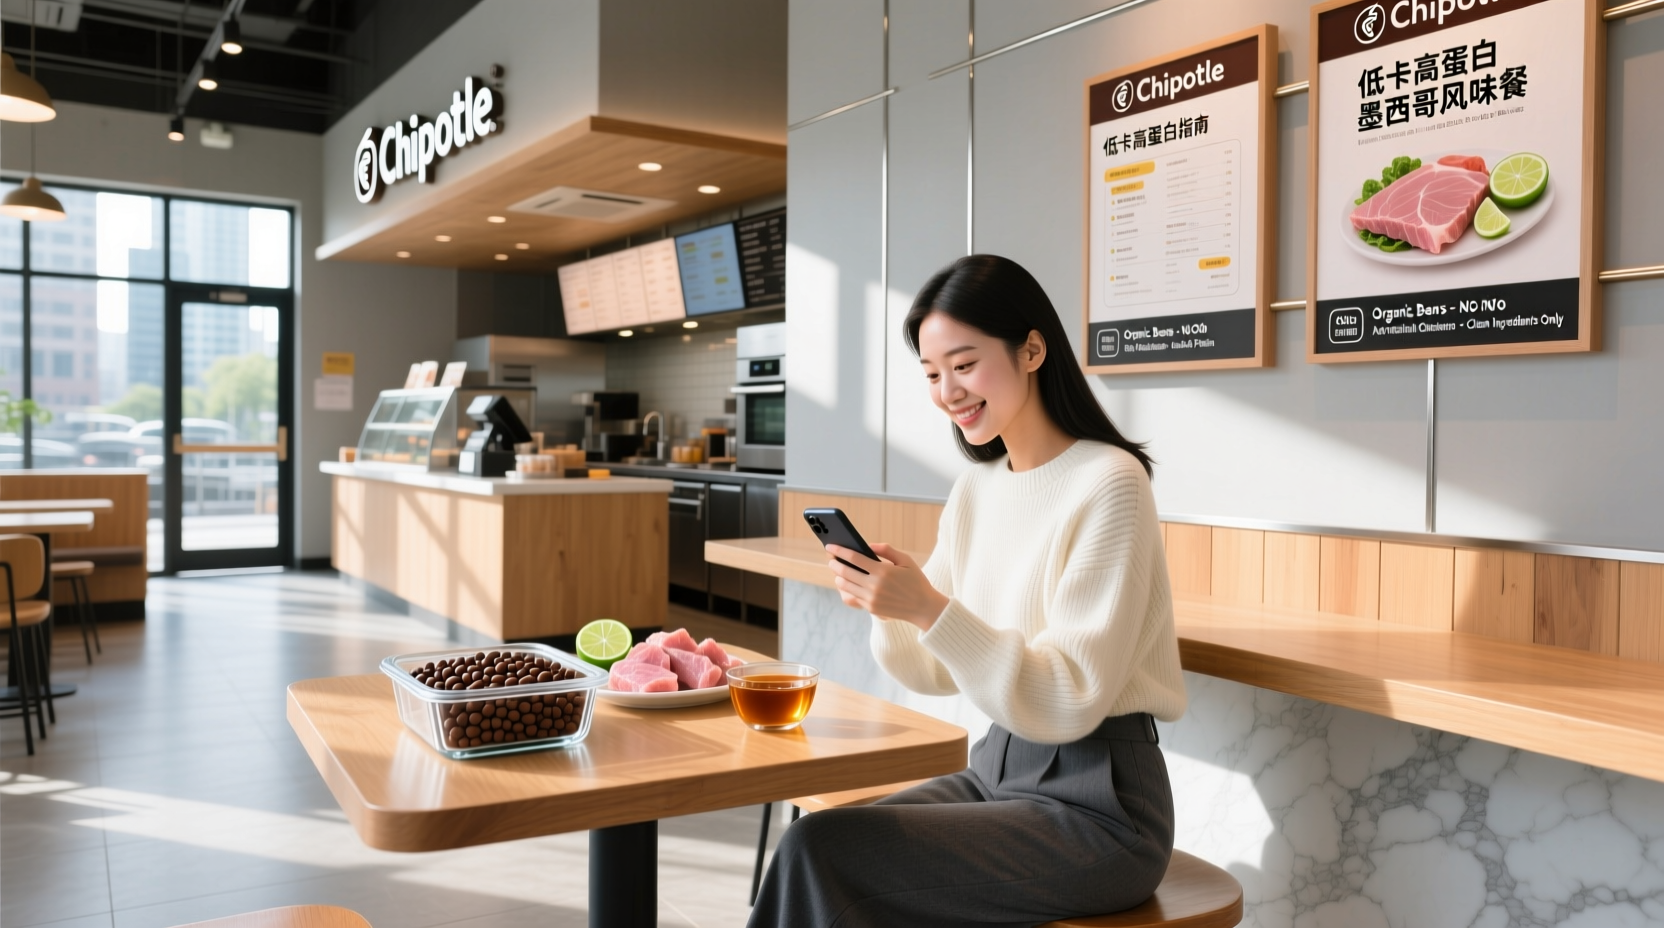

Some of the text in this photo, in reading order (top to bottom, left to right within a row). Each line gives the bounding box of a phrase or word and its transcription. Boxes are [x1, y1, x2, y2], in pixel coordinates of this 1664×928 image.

[1391, 0, 1498, 28] Chipo
[1137, 60, 1224, 100] Chipotle
[1358, 39, 1497, 99] 低卡高蛋白
[1358, 65, 1528, 132] 墨西哥风味餐
[379, 76, 493, 184] Chipotle
[1103, 113, 1209, 157] 低卡高蛋白指南
[1540, 311, 1564, 328] Only
